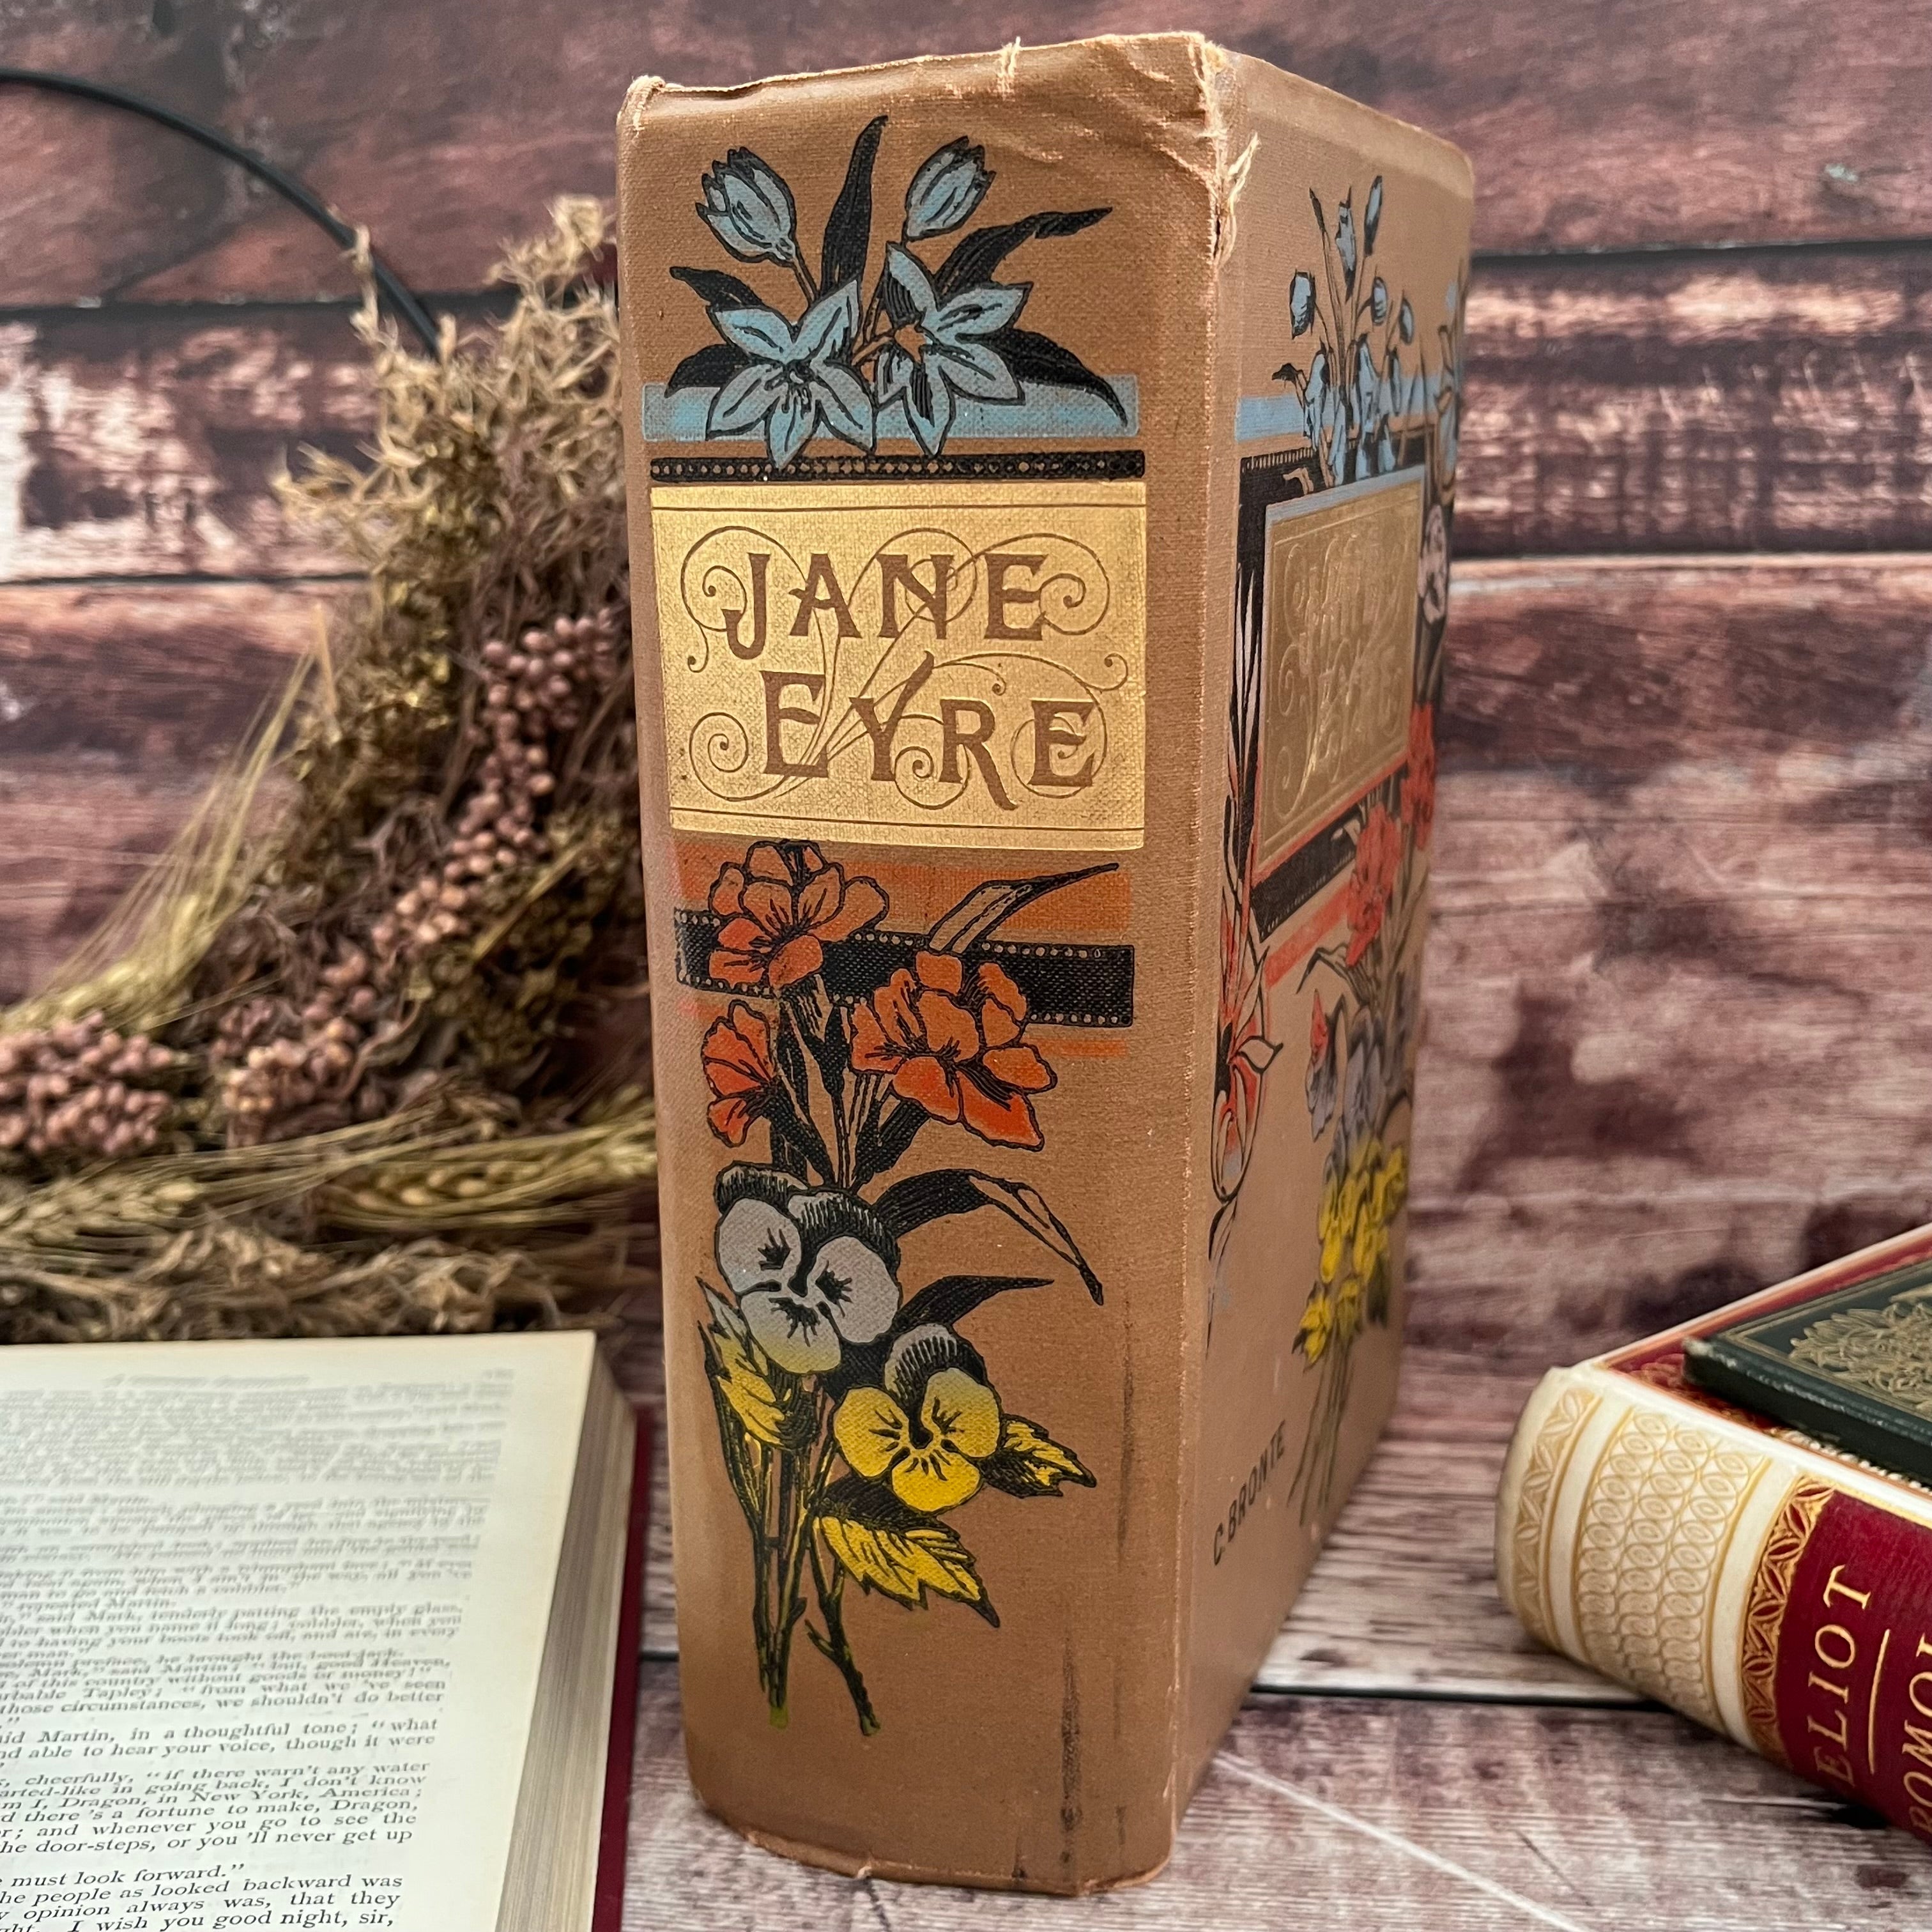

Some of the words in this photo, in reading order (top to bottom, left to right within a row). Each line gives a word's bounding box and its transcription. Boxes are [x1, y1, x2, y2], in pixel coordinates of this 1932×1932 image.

[722, 553, 1050, 660] JANE
[762, 650, 1096, 811] EYRE
[1228, 1419, 1285, 1544] BRONTE
[1807, 1564, 1872, 1787] ELIOT
[36, 1729, 115, 1744] Martin,
[130, 1728, 150, 1741] in
[164, 1729, 174, 1739] a
[184, 1722, 291, 1740] thoughtful
[28, 1745, 72, 1758] able
[84, 1745, 103, 1757] to
[110, 1744, 158, 1756] hear
[161, 1743, 211, 1758] your
[219, 1739, 275, 1753] voice,
[286, 1735, 356, 1751] though
[365, 1735, 378, 1747] it
[388, 1735, 435, 1746] were
[25, 1772, 134, 1786] cheerfully,
[192, 1768, 245, 1779] there
[255, 1765, 319, 1777] warn’t
[327, 1765, 365, 1775] any
[372, 1761, 430, 1773] water
[112, 1782, 132, 1794] in
[145, 1781, 208, 1795] going
[216, 1778, 270, 1790] back,
[279, 1776, 292, 1788] I
[303, 1775, 358, 1787] don’t
[369, 1774, 427, 1786] know
[24, 1810, 80, 1823] there
[111, 1811, 123, 1820] a
[135, 1806, 215, 1819] fortune
[227, 1803, 249, 1814] to
[256, 1801, 321, 1814] make,
[328, 1798, 418, 1813] Dragon,
[30, 1798, 49, 1810] I,
[58, 1796, 148, 1809] Dragon,
[156, 1793, 178, 1804] in
[188, 1791, 240, 1803] New
[250, 1789, 309, 1800] York,
[36, 1823, 79, 1837] and
[93, 1821, 197, 1835] whenever
[206, 1820, 246, 1834] you
[259, 1818, 287, 1831] go
[300, 1815, 321, 1827] to
[334, 1815, 368, 1825] see
[383, 1812, 417, 1824] the
[35, 1838, 156, 1854] door-steps,
[167, 1838, 192, 1849] or
[195, 1836, 237, 1851] you
[275, 1832, 336, 1843] never
[342, 1828, 378, 1845] get
[387, 1829, 413, 1844] up
[10, 1873, 68, 1888] must
[73, 1869, 126, 1885] look
[31, 1887, 111, 1907] people
[119, 1886, 144, 1899] as
[150, 1880, 230, 1897] looked
[243, 1873, 352, 1892] backward
[360, 1876, 403, 1888] was
[23, 1904, 111, 1924] opinion
[126, 1899, 206, 1915] always
[223, 1896, 272, 1910] was,
[289, 1891, 336, 1906] that
[350, 1890, 401, 1910] they
[68, 1919, 84, 1932] I
[96, 1916, 148, 1931] wish
[159, 1916, 205, 1932] you
[211, 1910, 273, 1930] good
[279, 1908, 348, 1929] night,
[358, 1909, 394, 1928] sir,
